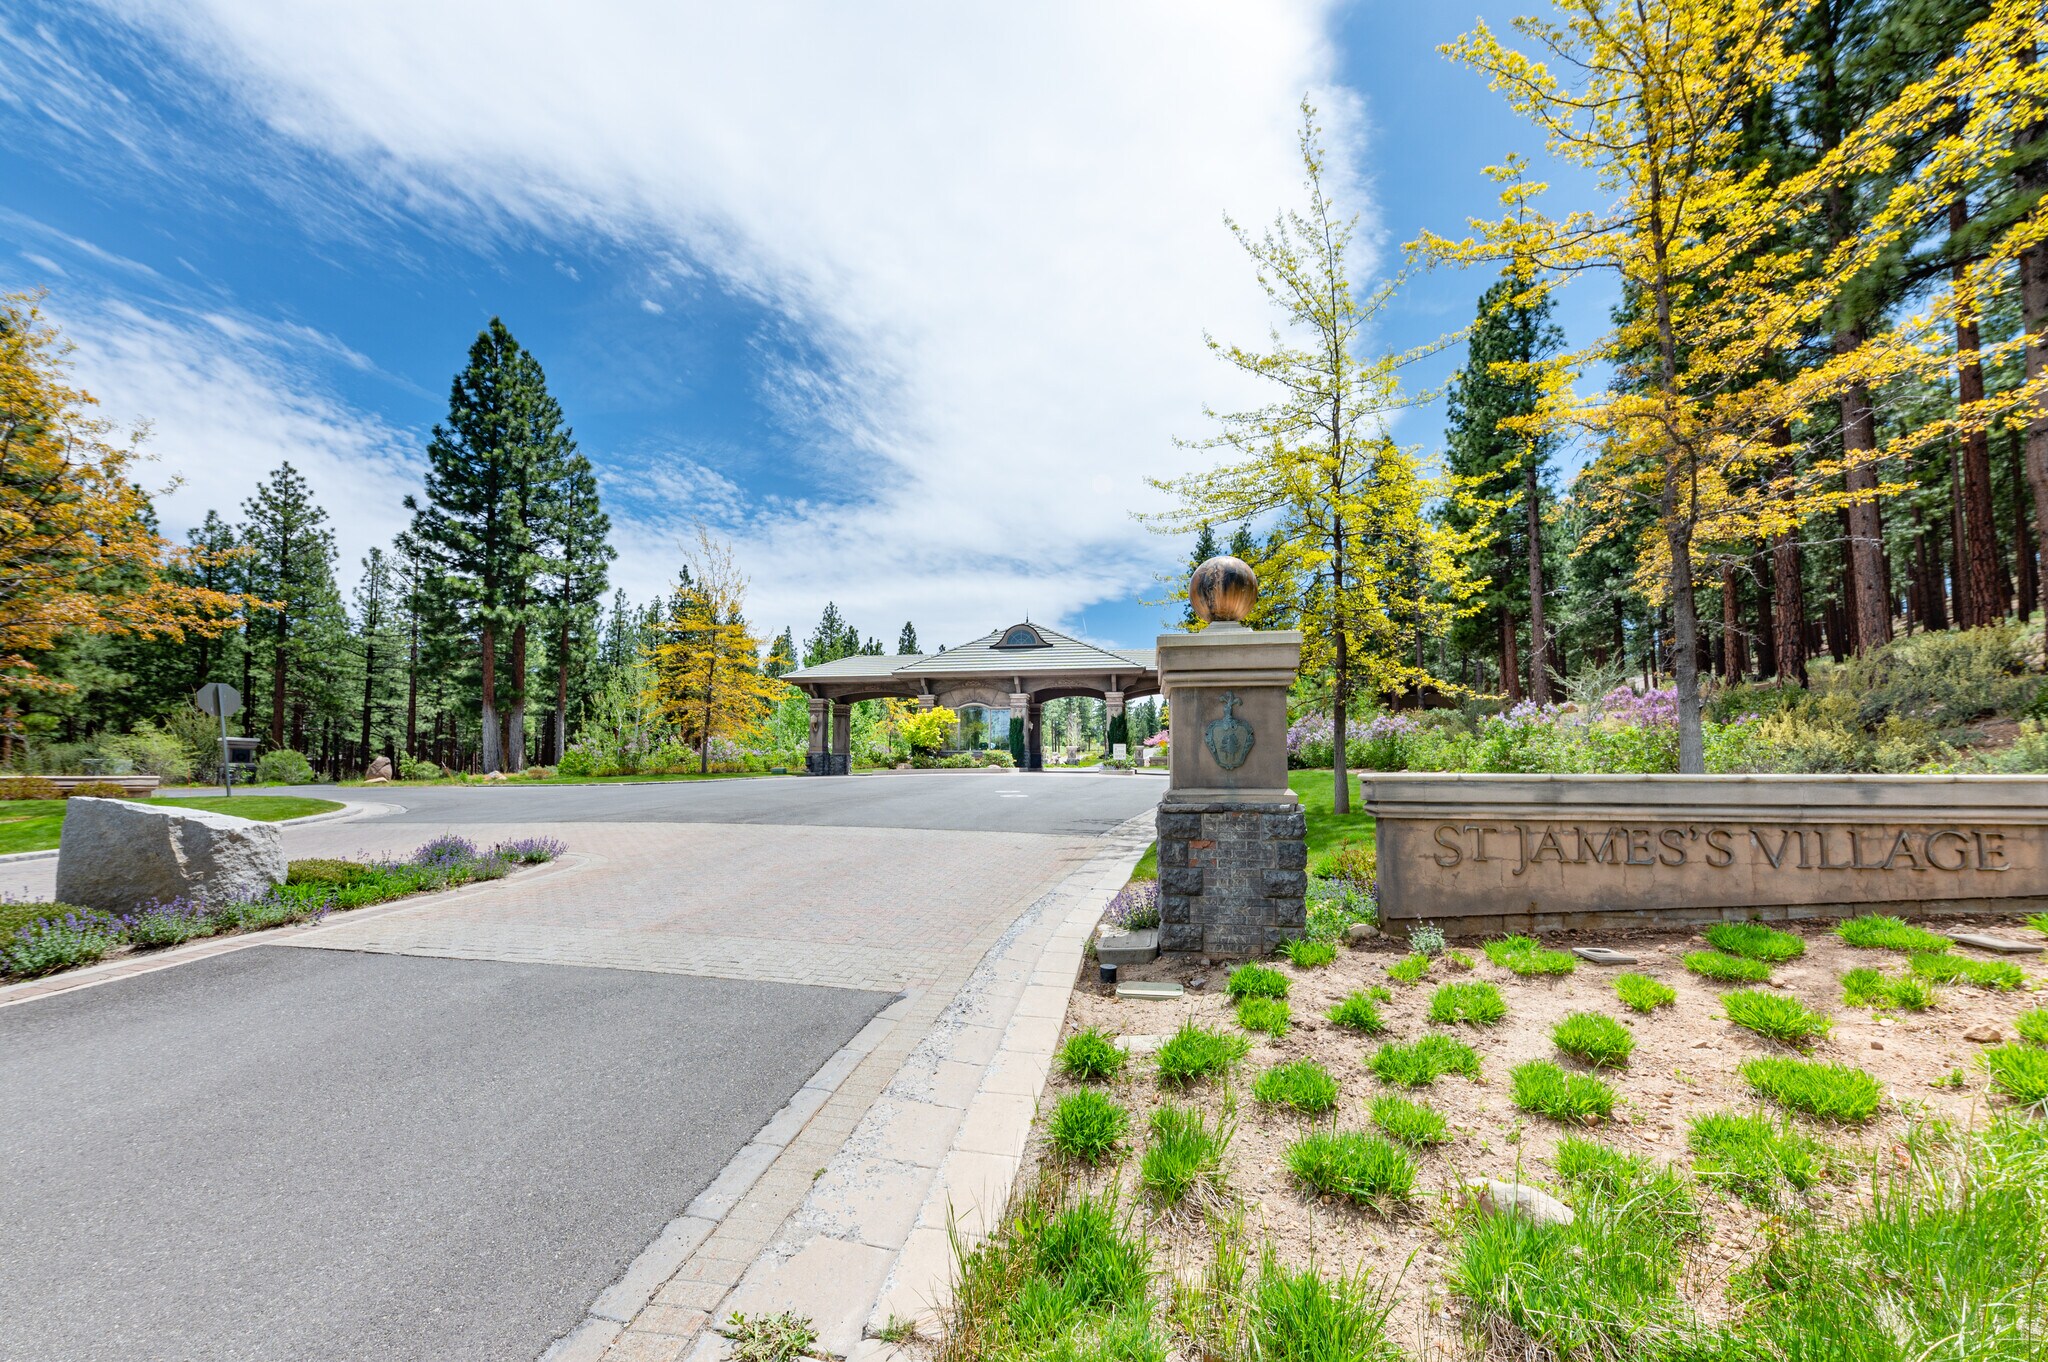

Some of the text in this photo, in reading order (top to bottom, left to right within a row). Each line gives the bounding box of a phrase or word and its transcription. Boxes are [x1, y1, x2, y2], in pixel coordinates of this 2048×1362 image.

[1433, 824, 2011, 876] ST JAMES'S VILLAGE
